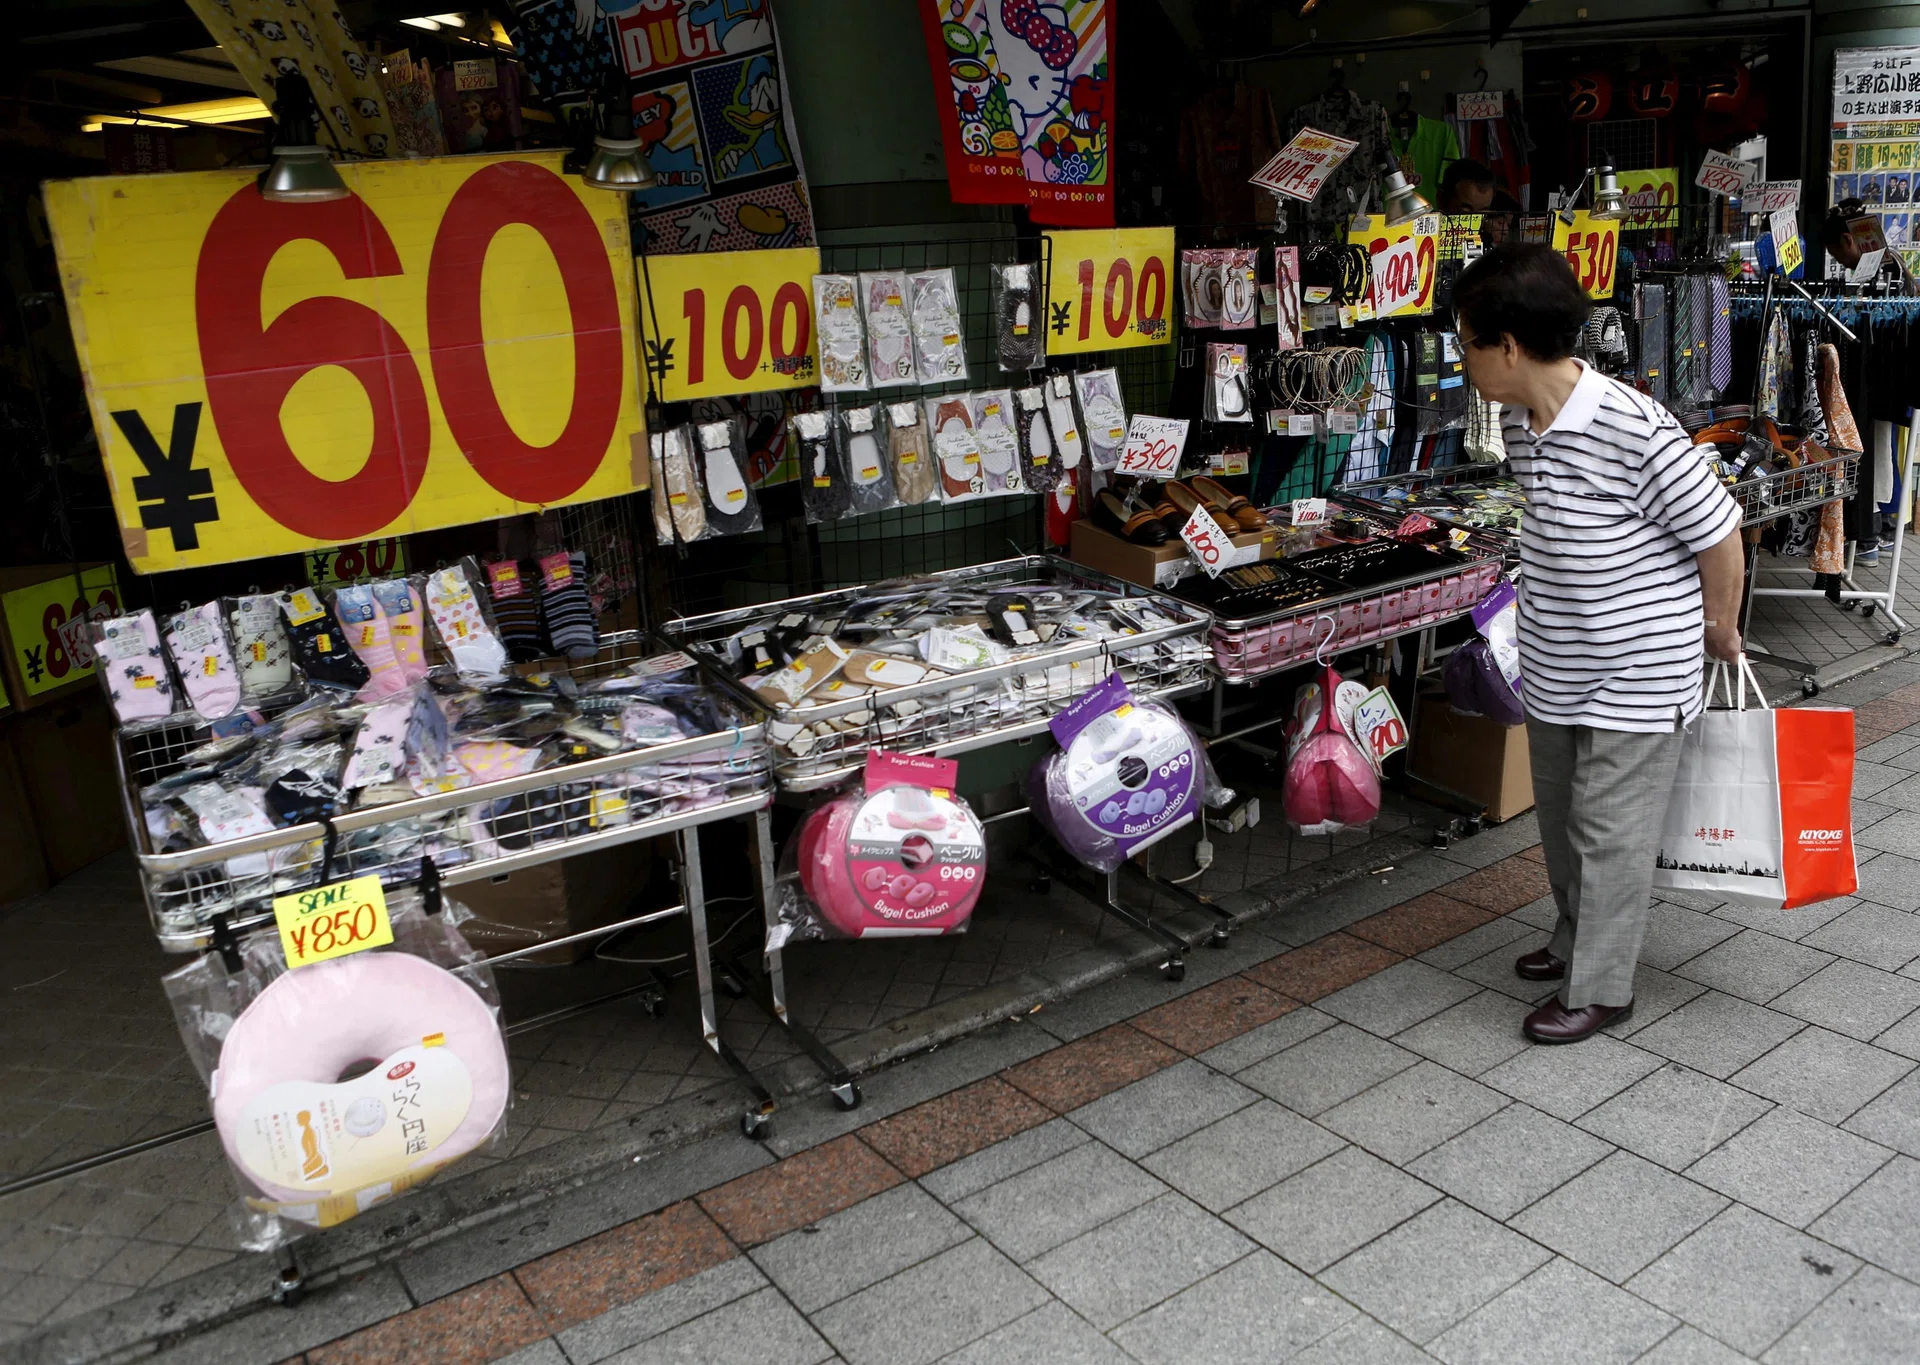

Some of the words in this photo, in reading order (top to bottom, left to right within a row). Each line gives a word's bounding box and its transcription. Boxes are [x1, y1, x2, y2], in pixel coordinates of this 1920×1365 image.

[622, 17, 721, 73] DUC
[1873, 57, 1912, 69] お江戸
[632, 103, 662, 129] KEY
[656, 171, 703, 187] NALD
[1260, 157, 1316, 191] 100円
[1701, 168, 1741, 194] ¥390
[1051, 255, 1166, 342] ¥100
[646, 281, 810, 386] ¥100
[1151, 332, 1166, 340] とらや
[111, 161, 624, 551] ¥60
[760, 354, 814, 374] +消費税
[793, 370, 814, 381] とらや
[1122, 438, 1177, 472] ¥390
[1183, 518, 1220, 565] ¥100
[1067, 702, 1083, 717] Bagel
[1082, 688, 1104, 706] Cushion
[891, 757, 909, 768] Bagel
[911, 758, 935, 769] Cushion
[1123, 819, 1151, 836] Bagel
[1152, 792, 1185, 826] Cushion
[1694, 826, 1736, 842] 崎陽軒
[940, 845, 982, 860] ベーグル
[298, 884, 353, 915] SALE
[874, 899, 903, 920] Bagel
[905, 902, 949, 920] Cushion
[290, 903, 377, 959] ¥850
